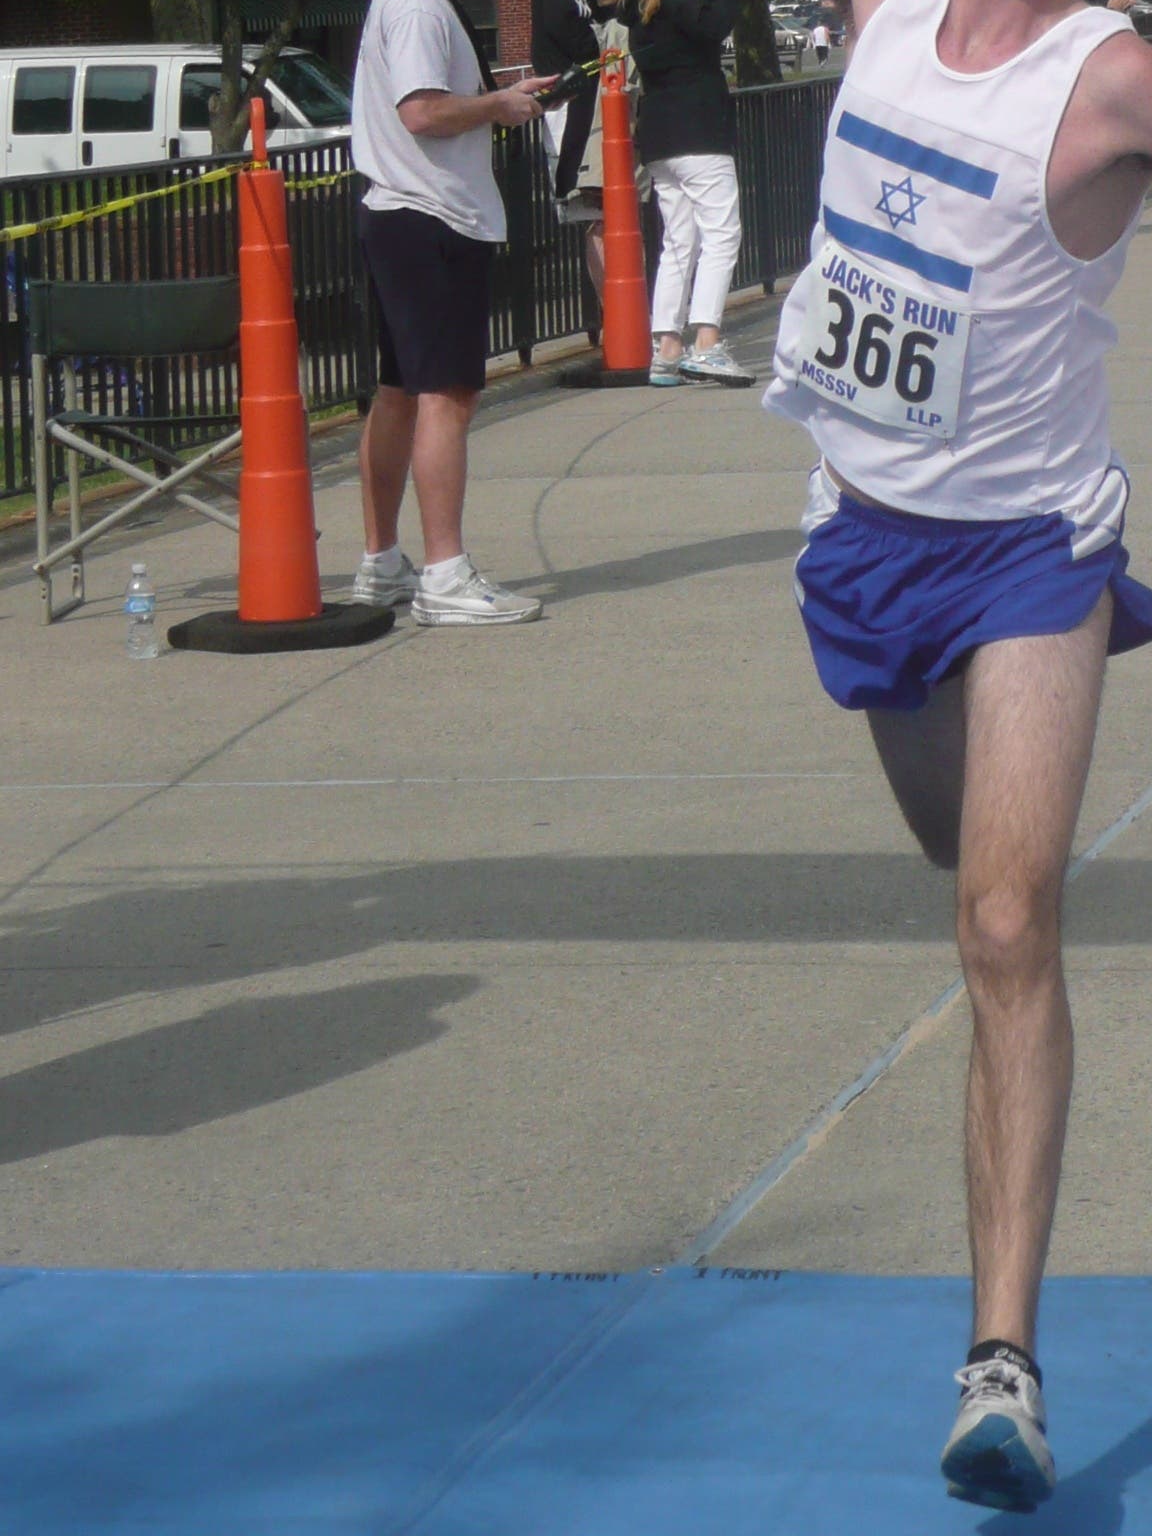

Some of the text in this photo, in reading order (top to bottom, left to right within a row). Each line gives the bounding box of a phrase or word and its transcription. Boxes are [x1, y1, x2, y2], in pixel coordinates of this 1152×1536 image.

[821, 255, 956, 336] JACK'S RUN
[814, 288, 938, 403] 366
[801, 360, 858, 402] MSSSV
[906, 407, 942, 427] LLP
